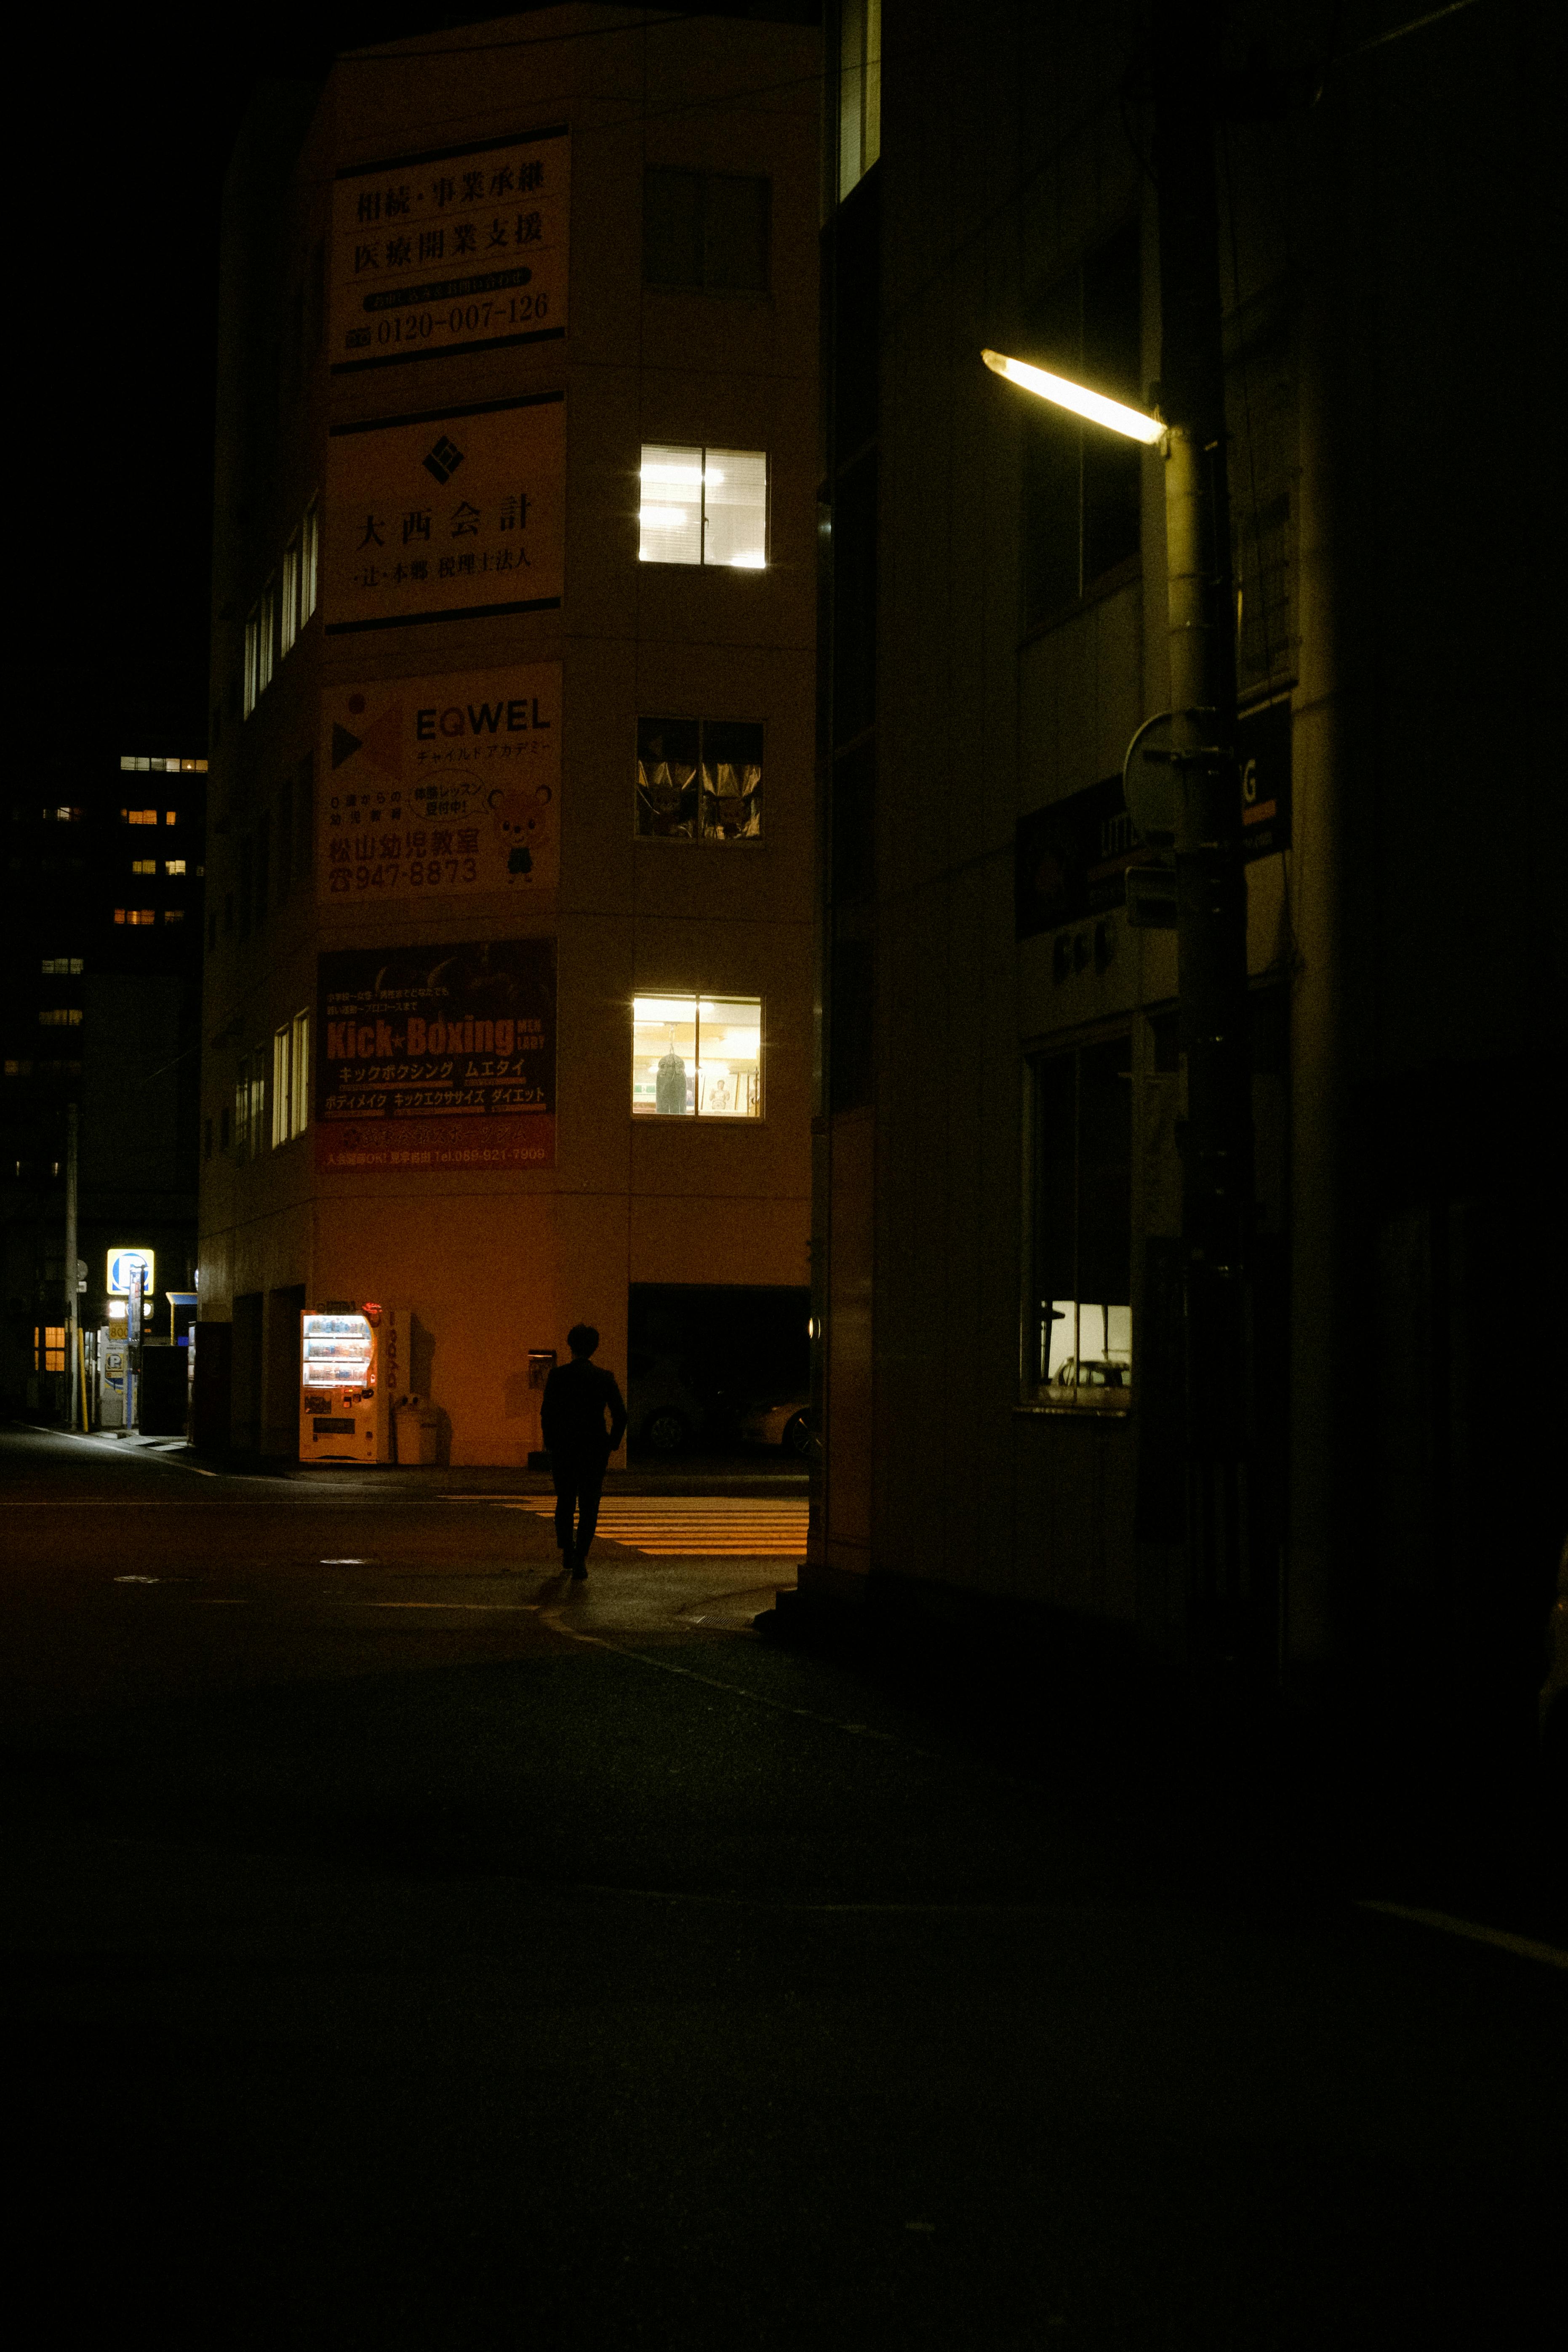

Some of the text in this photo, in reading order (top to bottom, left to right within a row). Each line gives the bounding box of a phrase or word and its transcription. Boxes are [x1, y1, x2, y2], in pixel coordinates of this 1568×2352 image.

[355, 211, 542, 274] 医療開業支援
[378, 292, 548, 344] 0120-007-126
[356, 493, 531, 552] 大西会計
[438, 547, 531, 578] 税理士法人
[416, 698, 551, 740] EQWEL
[329, 827, 480, 863] 松山幼児教室
[327, 1018, 393, 1059] Kick
[407, 1015, 515, 1057] Boxing
[339, 1058, 525, 1083] キックボクシング ムエタイ
[325, 1093, 387, 1110] ボディメイク
[491, 1086, 545, 1104] ダイエット
